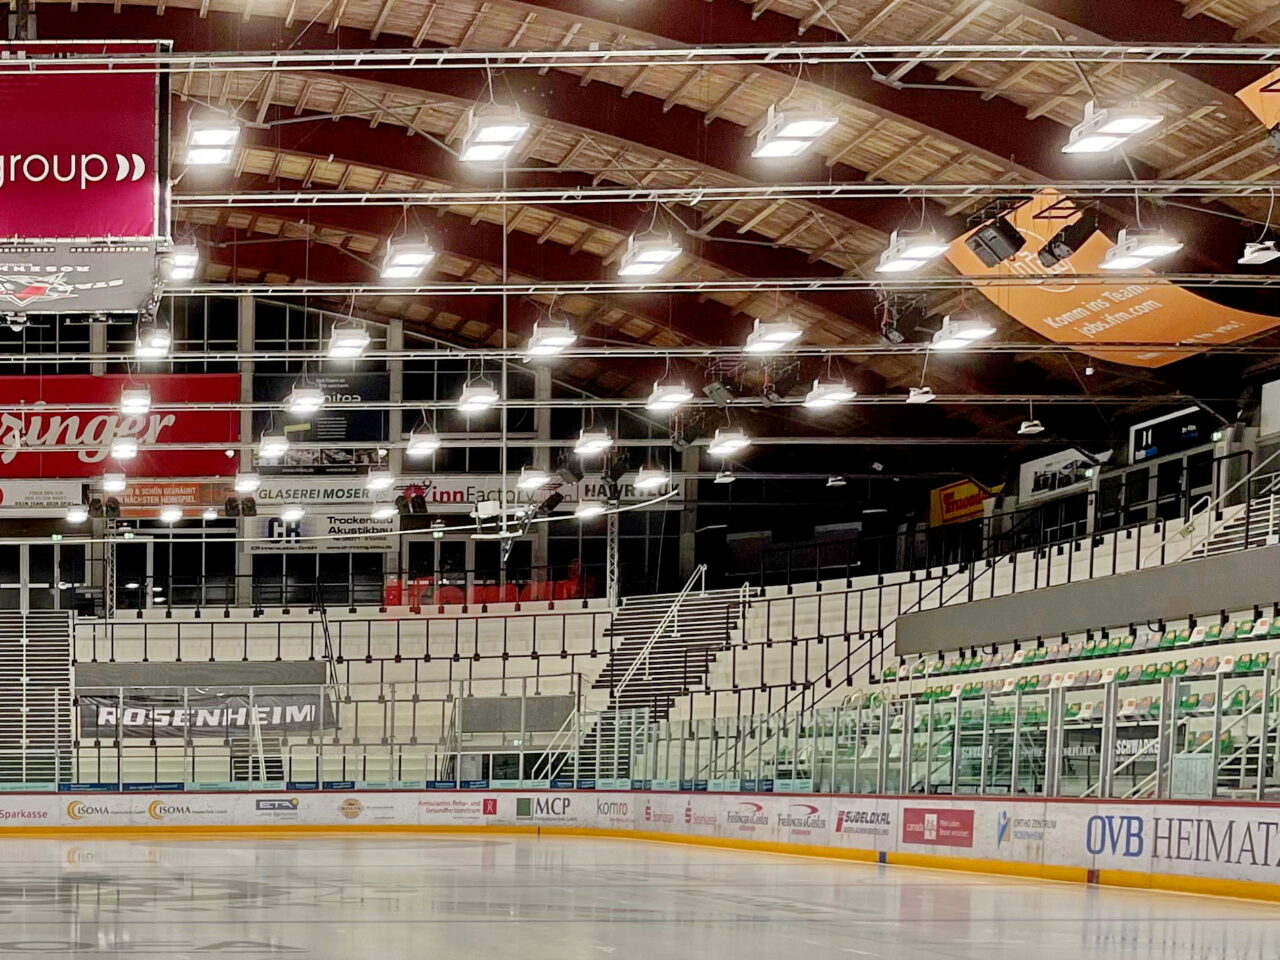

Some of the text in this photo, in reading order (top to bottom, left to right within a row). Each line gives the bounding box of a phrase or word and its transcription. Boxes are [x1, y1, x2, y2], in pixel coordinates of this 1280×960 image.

[1043, 304, 1089, 329] Komm
[1084, 297, 1111, 313] ins
[1073, 300, 1164, 338] jobs.ifm.com
[258, 488, 370, 500] GLASEREI MOSER
[327, 516, 394, 525] Trockenbau
[328, 526, 393, 535] Akustikbau
[97, 704, 316, 727] ROSENHEIM
[77, 804, 110, 815] ISOMA
[158, 804, 191, 815] ISOMA
[535, 797, 571, 815] MCP
[597, 797, 628, 816] komro
[845, 810, 891, 825] SÜDELOXAL
[1086, 815, 1280, 867] OVB HEIMAT
